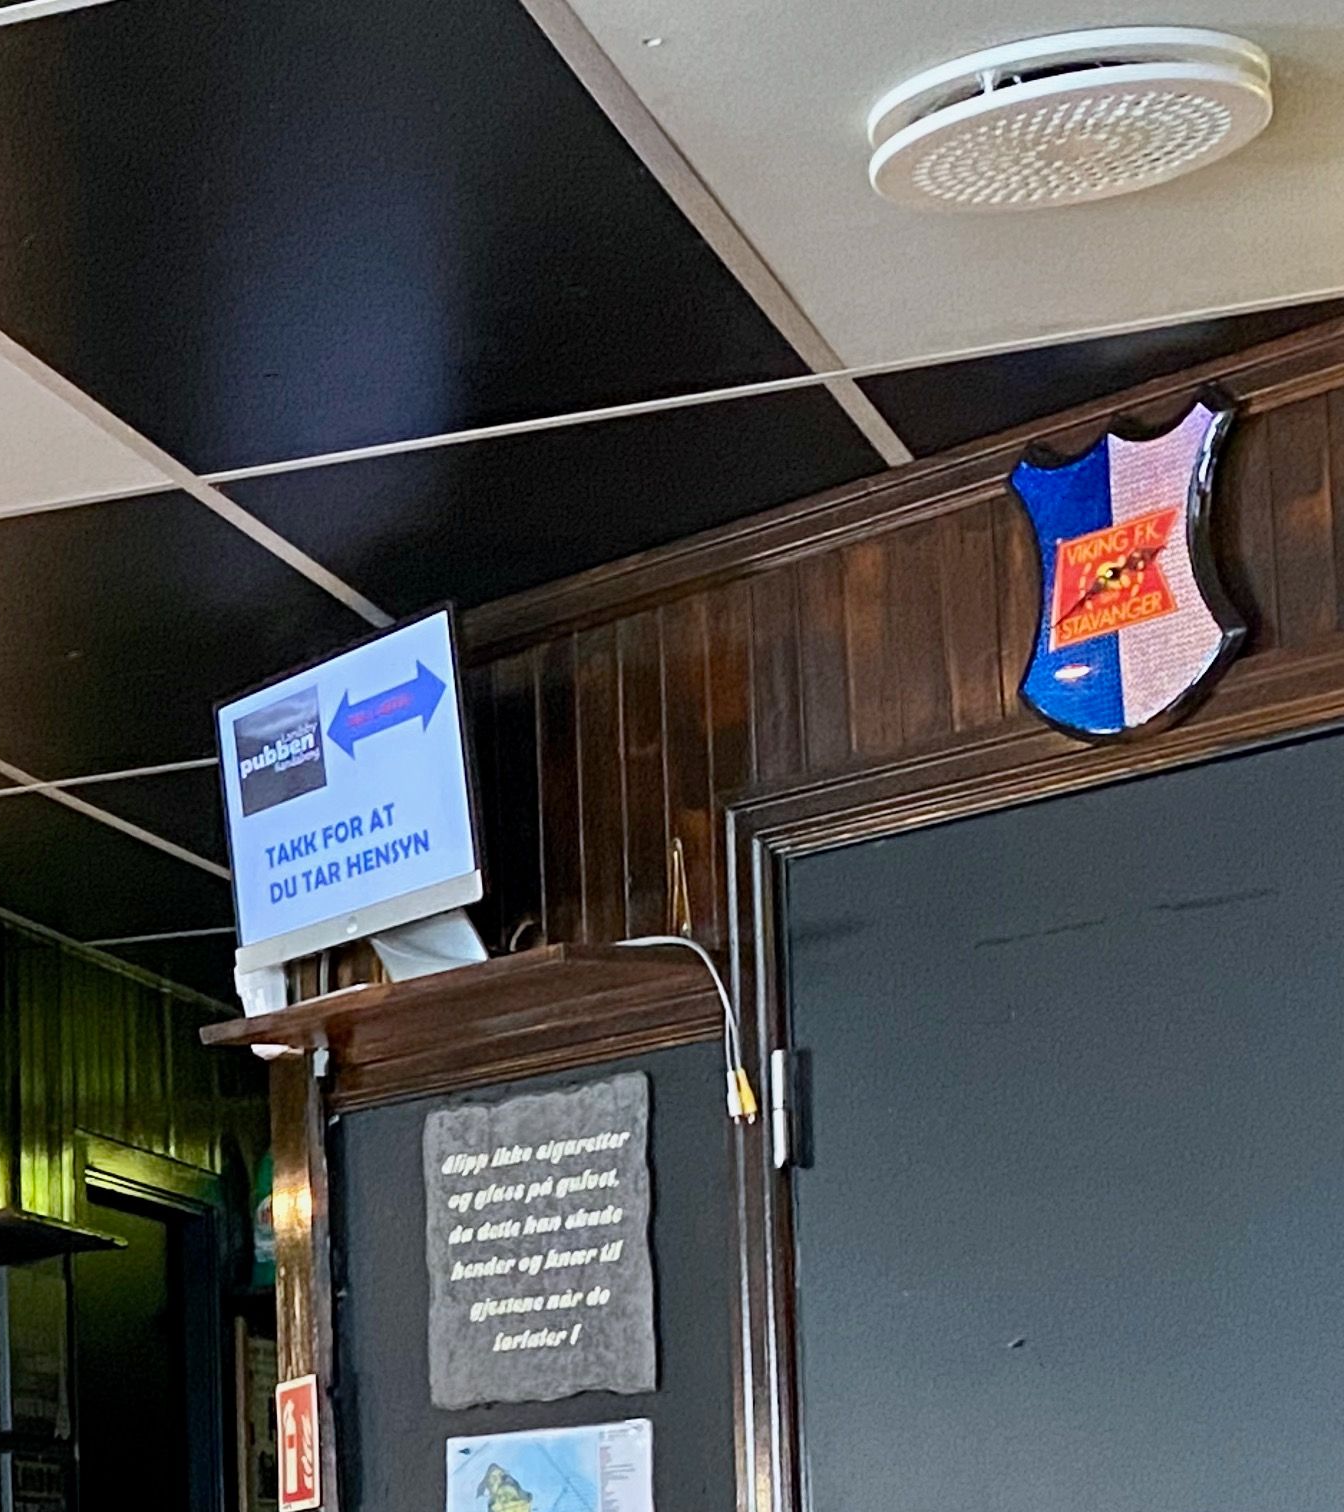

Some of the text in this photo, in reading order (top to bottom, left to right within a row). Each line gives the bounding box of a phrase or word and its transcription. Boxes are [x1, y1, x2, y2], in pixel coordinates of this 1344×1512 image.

[1066, 530, 1128, 565] VIKING
[1061, 592, 1163, 640] STAVANGER
[240, 732, 316, 779] pubben
[264, 802, 395, 869] TAKK FOR AT
[269, 829, 430, 905] DU TAR HENSYN
[536, 1130, 632, 1165] sigaretter
[447, 1191, 474, 1214] og
[474, 1183, 526, 1211] glass
[524, 1175, 555, 1204] på
[448, 1224, 475, 1245] da
[476, 1219, 522, 1242] dette
[450, 1255, 517, 1282] hender
[517, 1254, 545, 1276] og
[469, 1285, 612, 1323] gjestene når de
[492, 1327, 569, 1353] forlater
